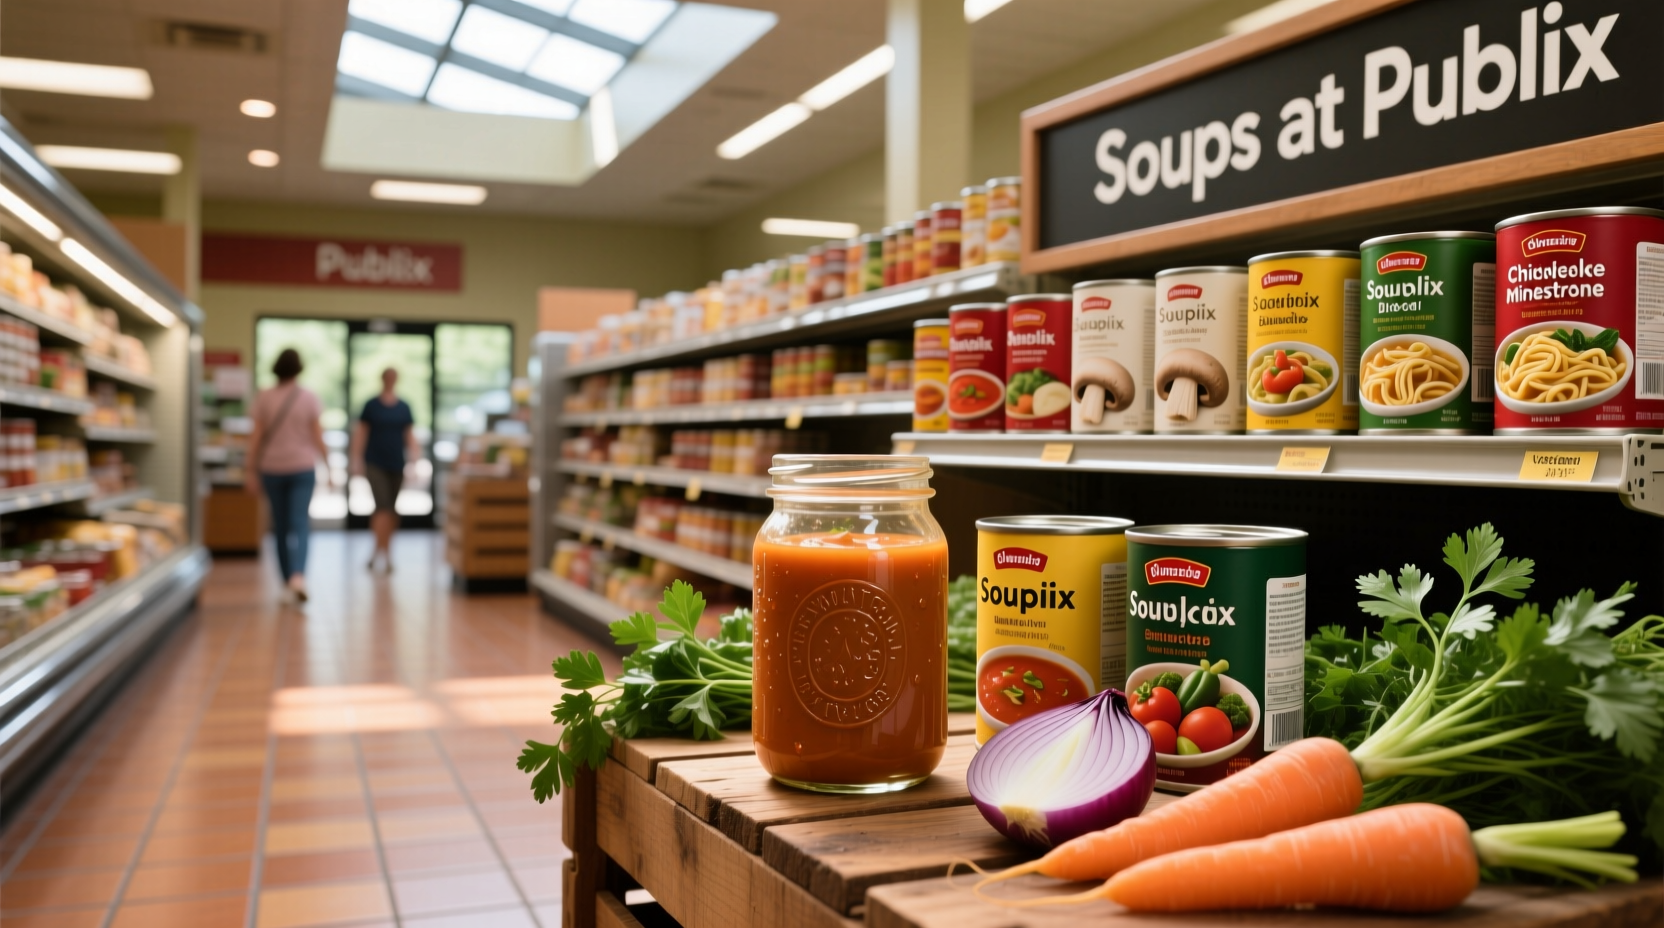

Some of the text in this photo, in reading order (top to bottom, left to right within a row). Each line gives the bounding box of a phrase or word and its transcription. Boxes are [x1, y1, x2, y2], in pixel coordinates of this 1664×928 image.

[1094, 1, 1621, 204] Soups at Publix
[315, 242, 435, 285] Publix
[1506, 281, 1605, 305] Minestrone
